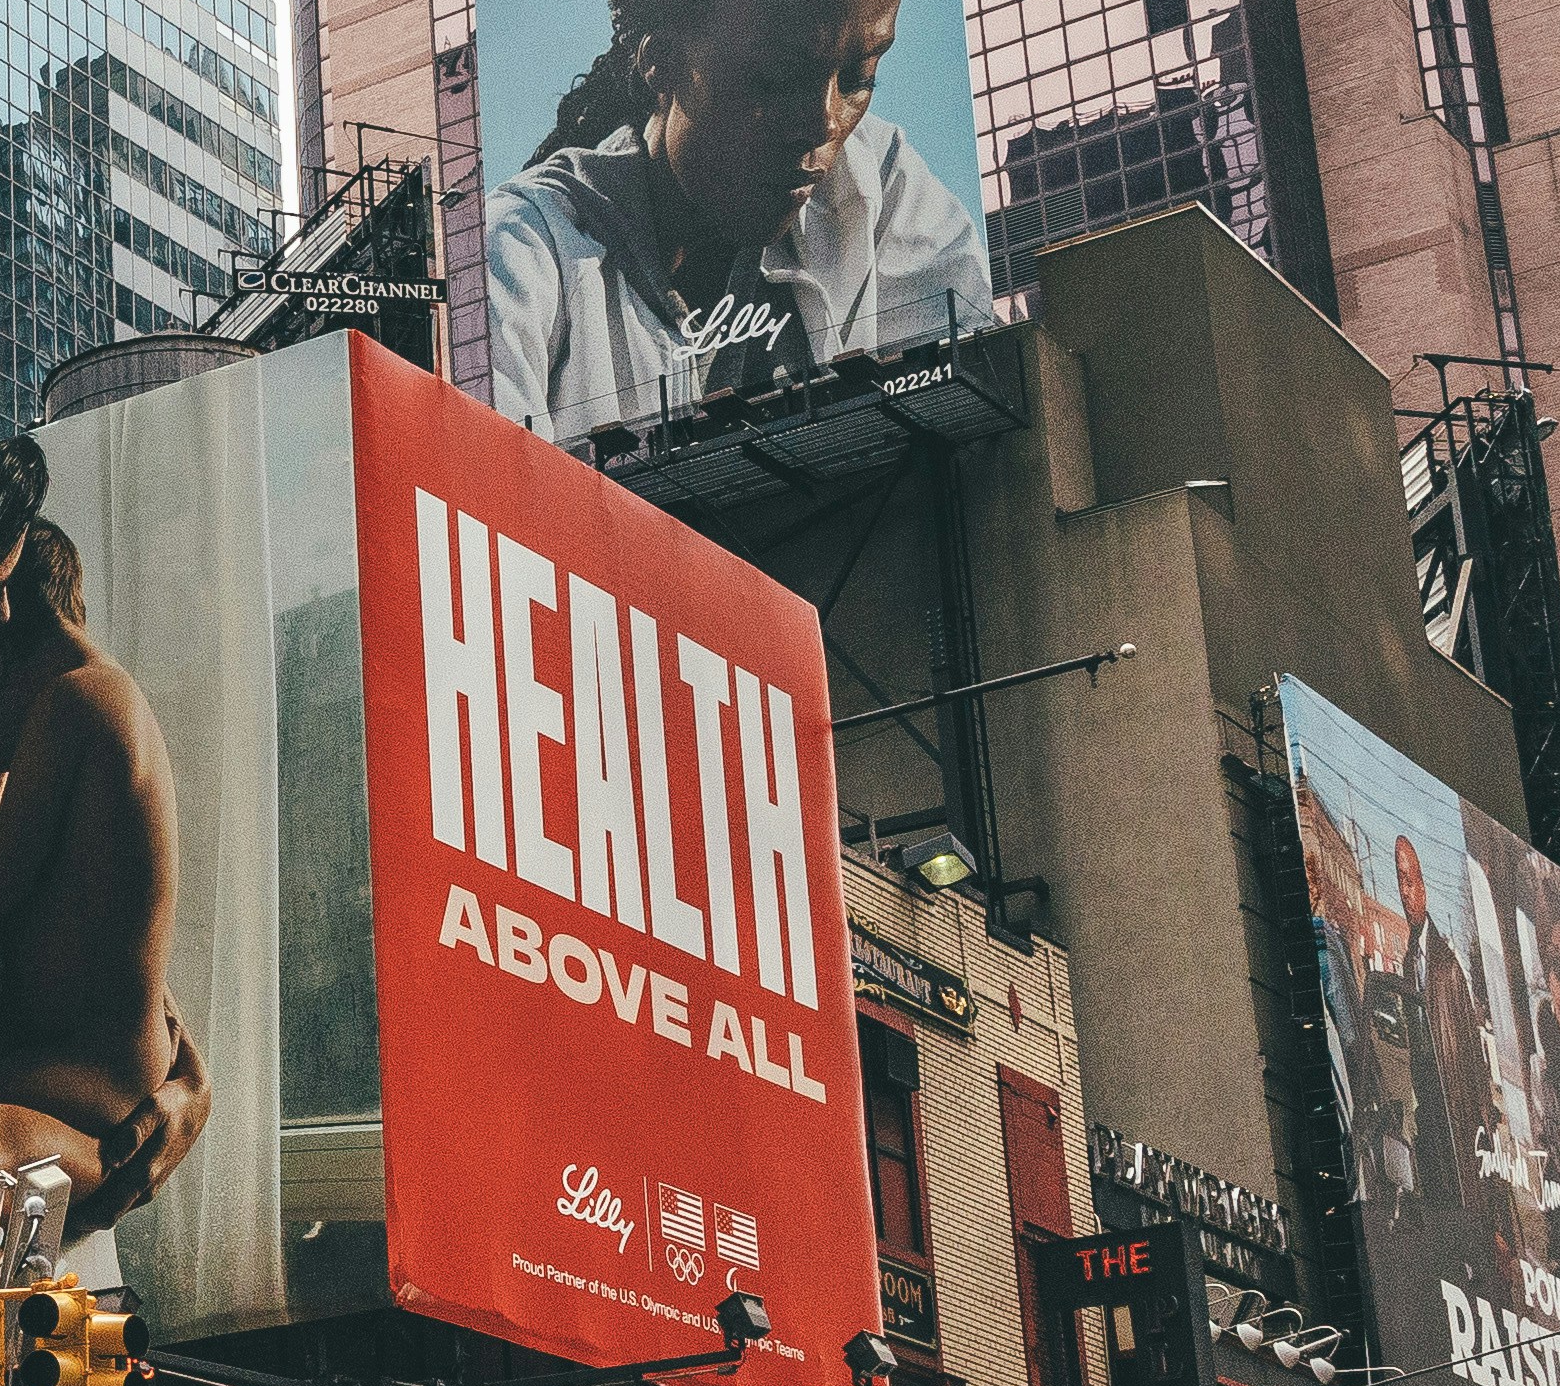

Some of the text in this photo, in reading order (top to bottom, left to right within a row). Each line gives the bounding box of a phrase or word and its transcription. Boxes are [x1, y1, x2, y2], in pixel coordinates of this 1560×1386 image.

[305, 296, 380, 317] 022280
[671, 293, 793, 362] Lilly
[883, 362, 956, 399] 022241
[414, 485, 819, 1012] HEALTH
[438, 883, 828, 1106] ABOVE ALL
[557, 1163, 635, 1255] Lilly
[1076, 1240, 1150, 1282] THE
[512, 1253, 805, 1363] Proud Partner of the U.S. Olympic and Teams
